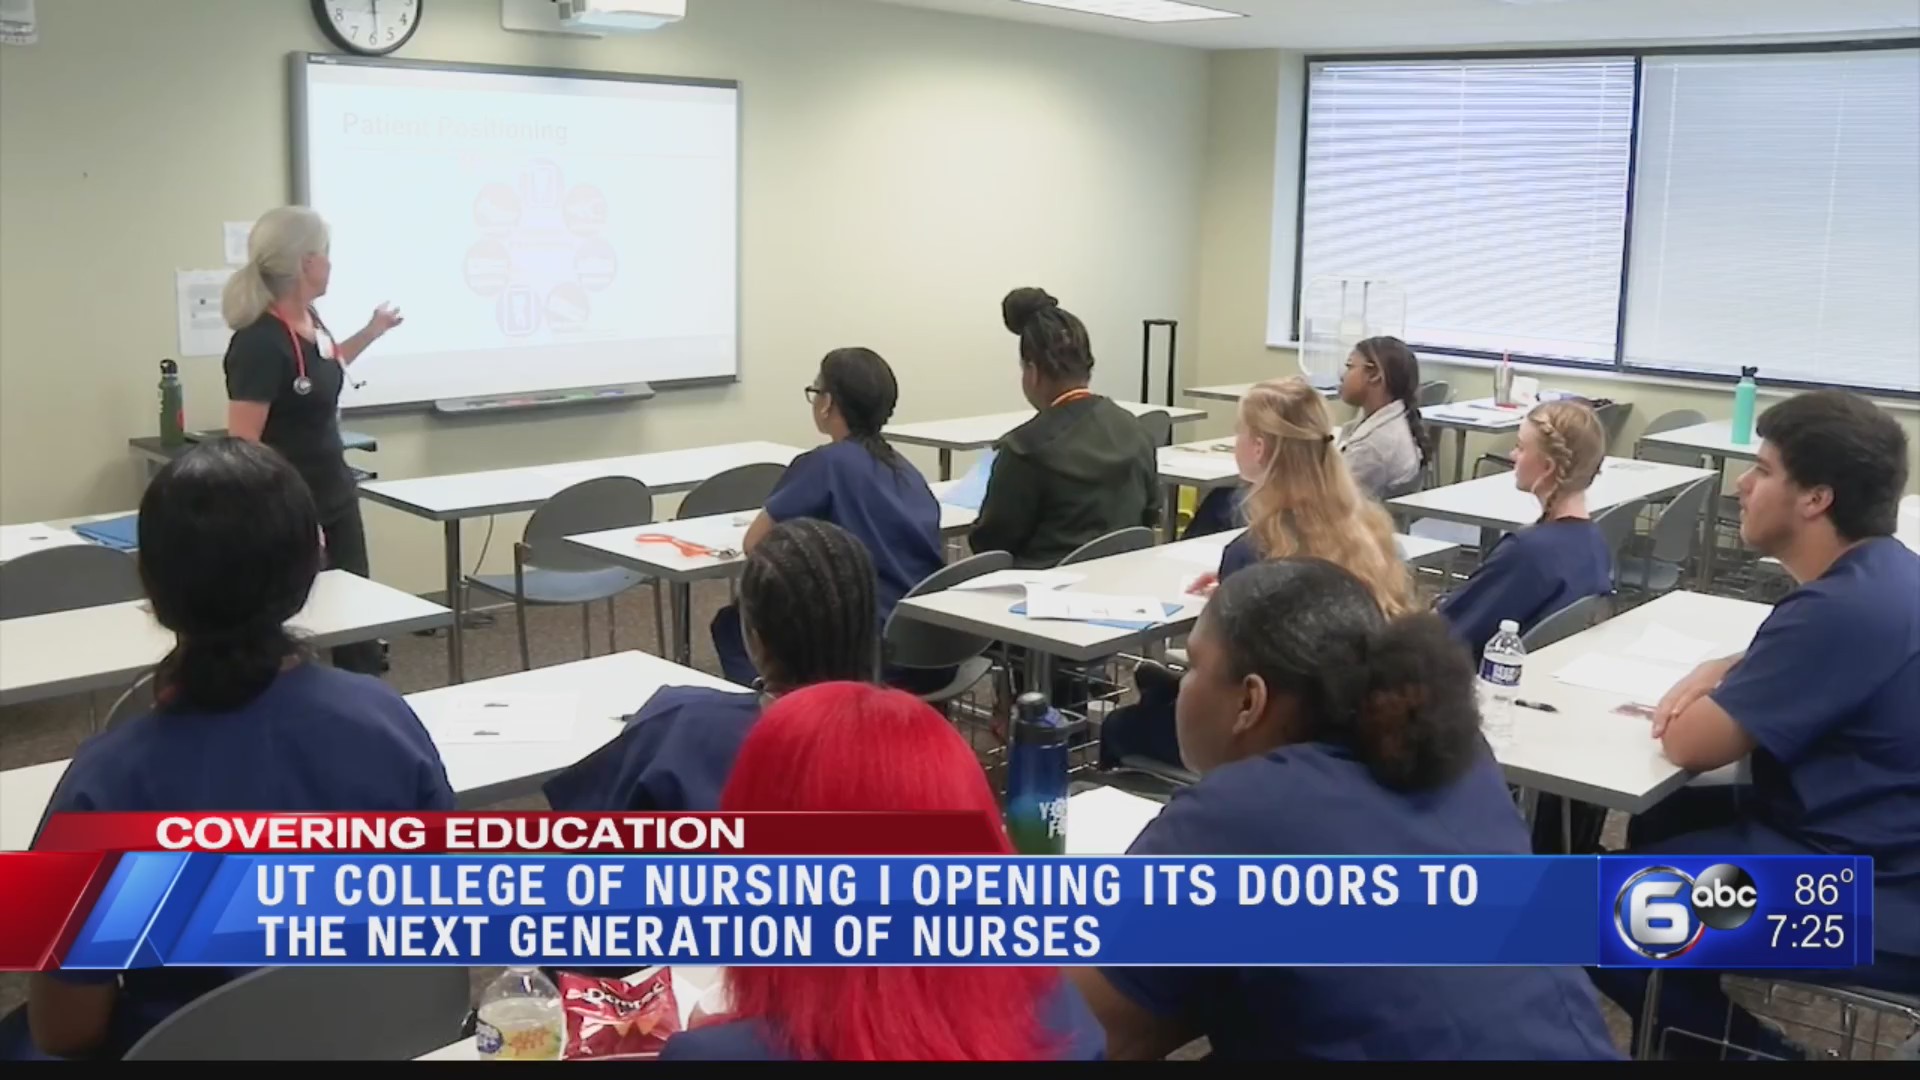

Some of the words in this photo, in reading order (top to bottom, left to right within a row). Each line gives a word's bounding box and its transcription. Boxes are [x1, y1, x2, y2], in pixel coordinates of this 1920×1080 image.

[334, 8, 345, 22] 8
[400, 13, 407, 26] 4
[350, 26, 359, 40] 7
[368, 32, 377, 46] 6
[386, 27, 395, 41] 5
[342, 112, 430, 138] Patient
[436, 114, 569, 146] Positioning
